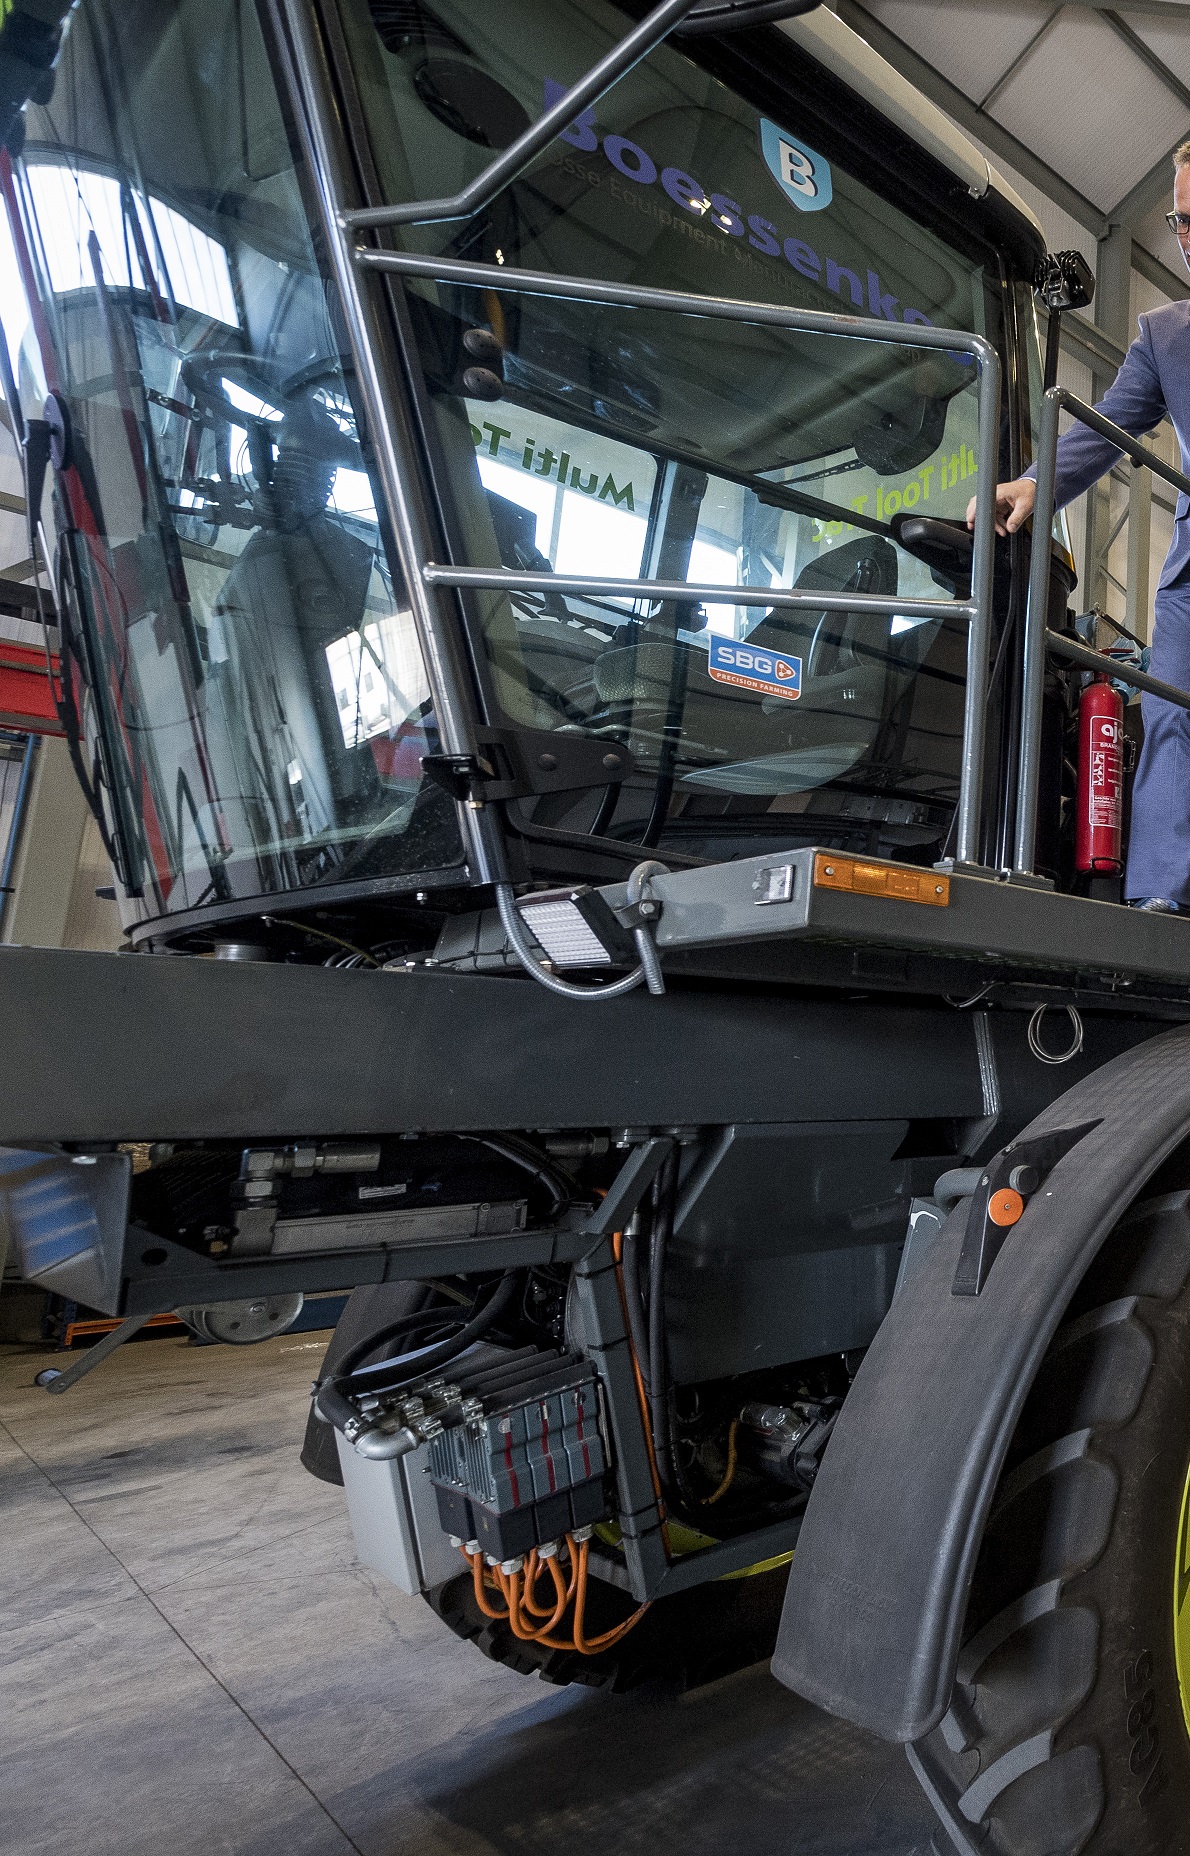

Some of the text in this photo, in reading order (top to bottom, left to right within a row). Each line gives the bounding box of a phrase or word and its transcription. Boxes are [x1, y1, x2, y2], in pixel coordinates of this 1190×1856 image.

[717, 646, 773, 674] SBG
[716, 672, 794, 697] PRECISION FARMING
